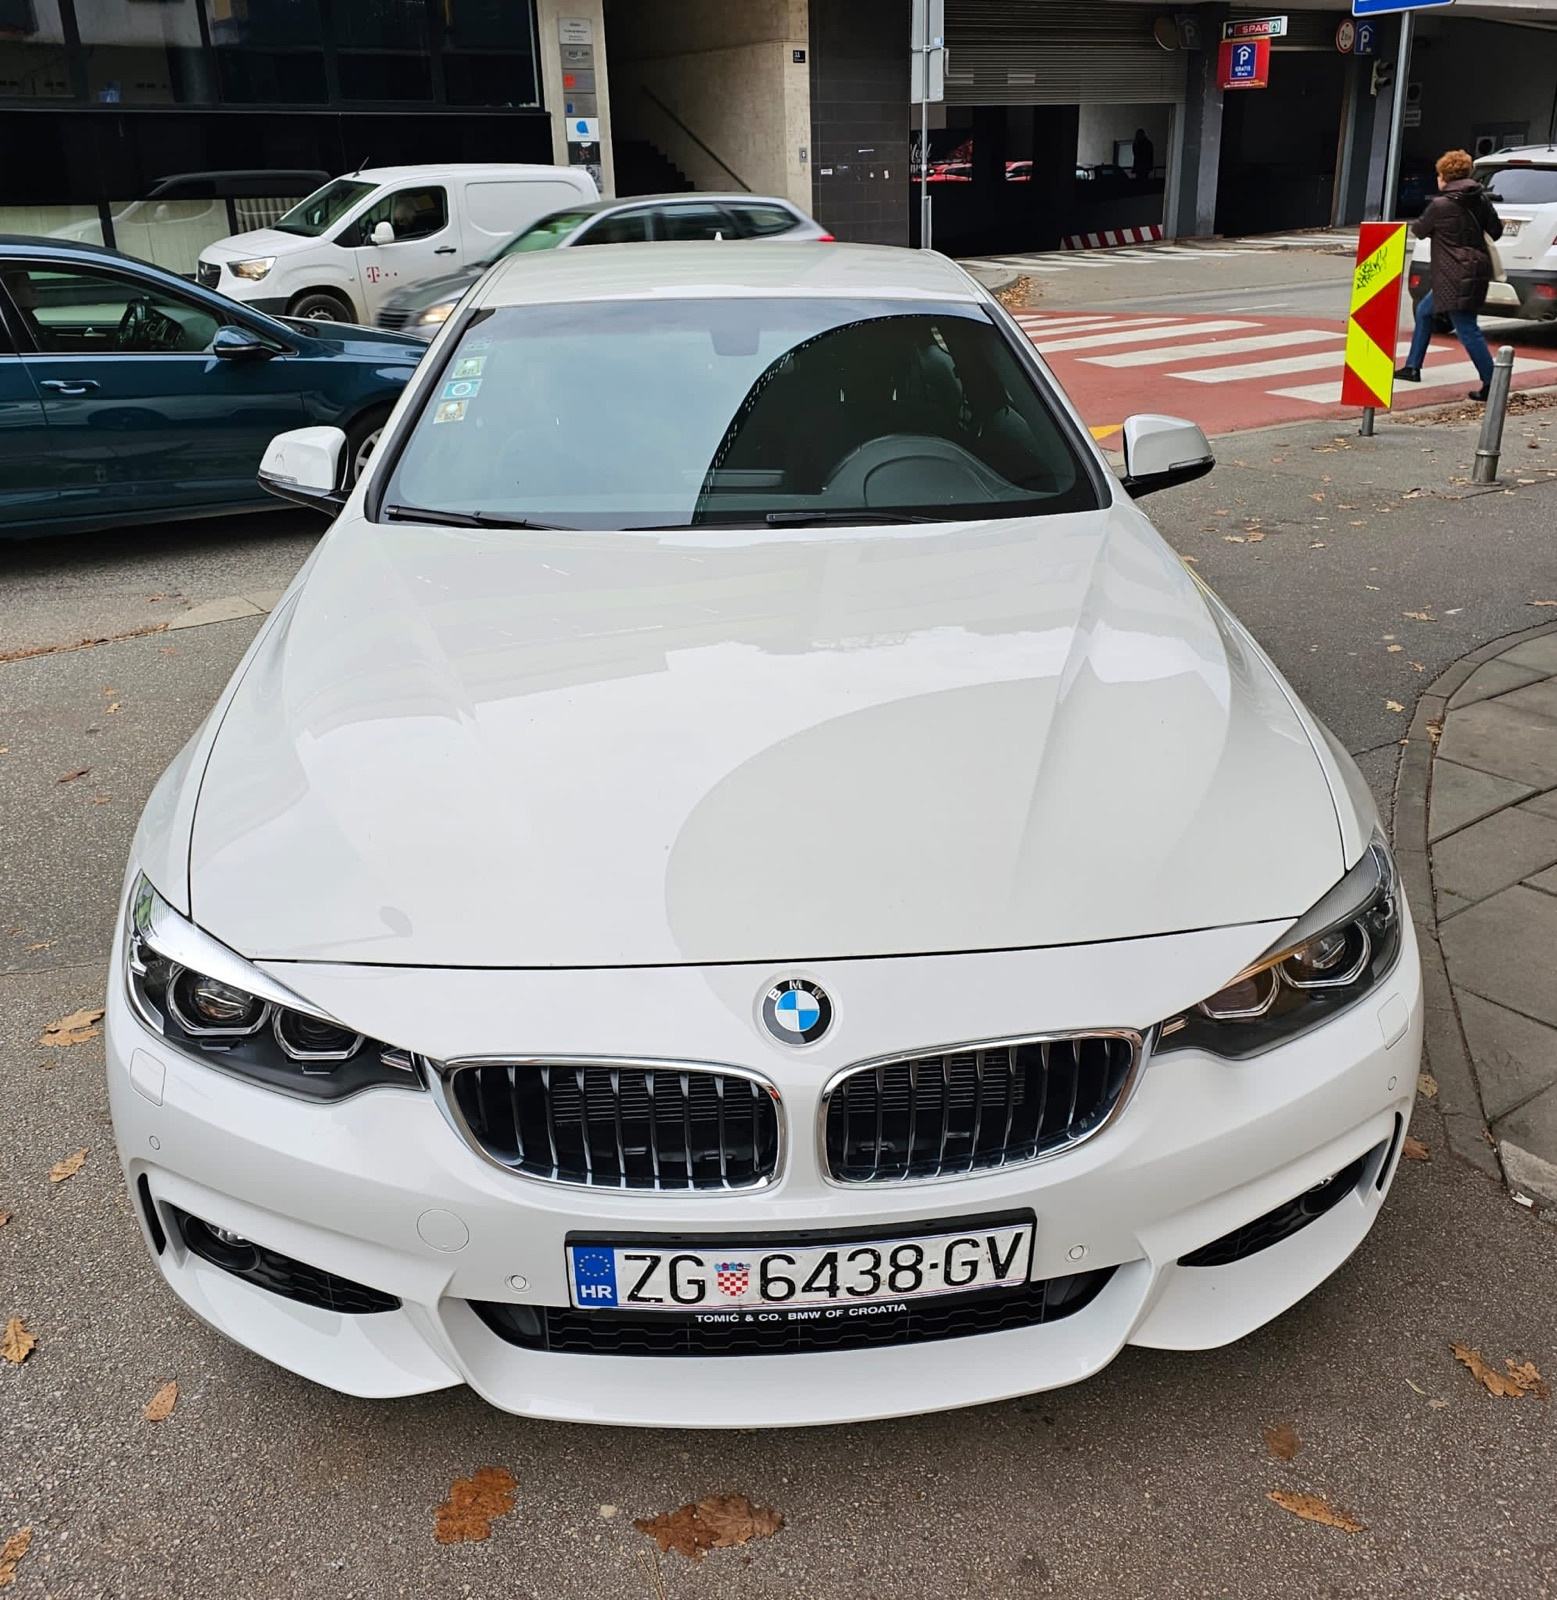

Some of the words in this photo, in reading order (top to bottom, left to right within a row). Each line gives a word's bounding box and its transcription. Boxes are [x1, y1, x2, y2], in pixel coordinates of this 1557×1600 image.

[1241, 24, 1269, 33] SPAR
[1361, 31, 1370, 51] P
[1240, 51, 1249, 65] P
[768, 980, 825, 1001] BMW
[623, 1253, 707, 1305] ZG
[580, 1285, 613, 1299] HR
[695, 1312, 740, 1323] TOMIĆ
[744, 1314, 754, 1322] &
[758, 1313, 783, 1322] CO.
[787, 1311, 821, 1320] BMW
[825, 1308, 844, 1318] OF
[848, 1303, 908, 1317] CROATIA
